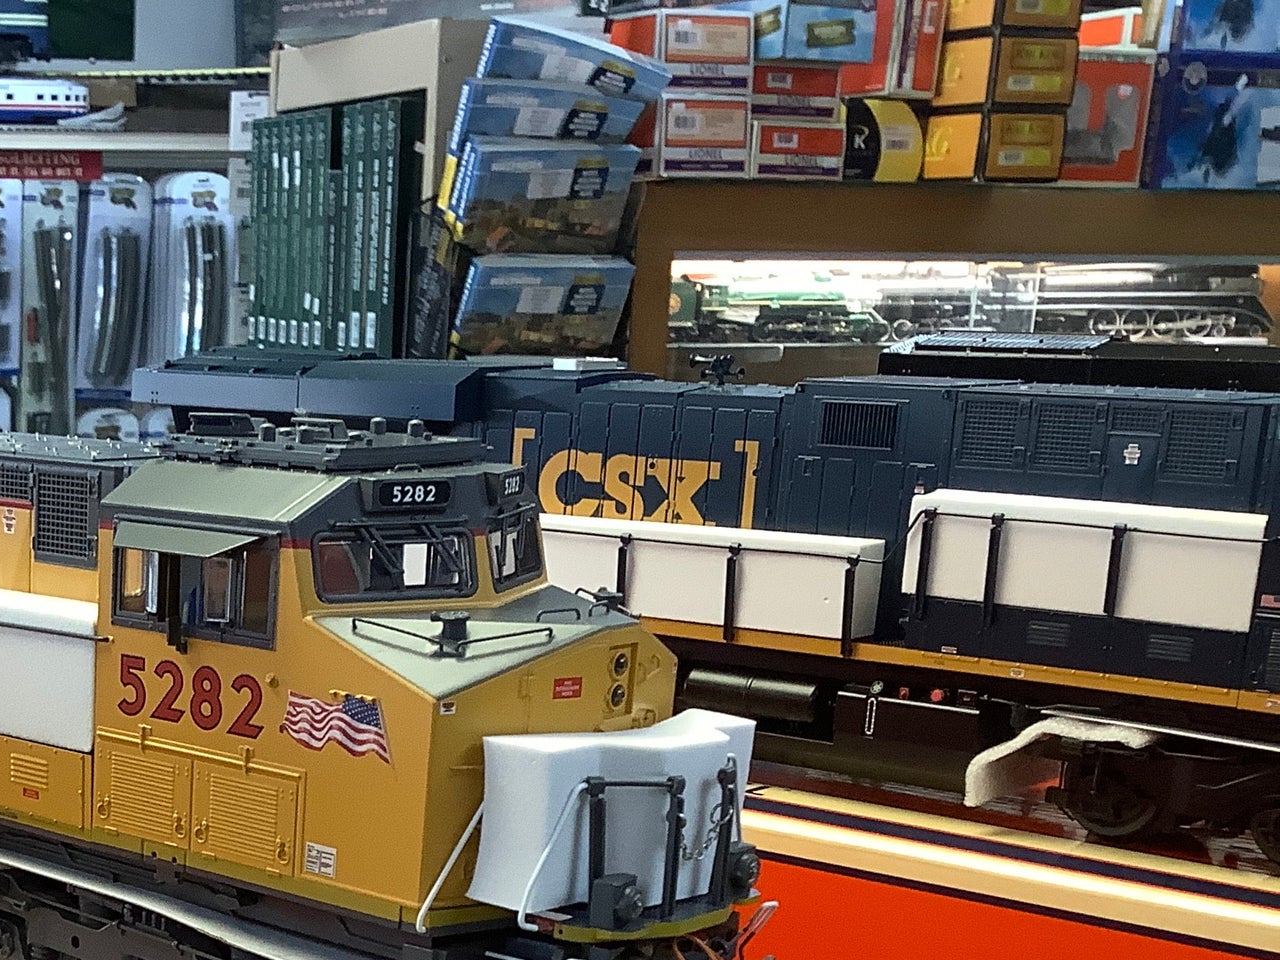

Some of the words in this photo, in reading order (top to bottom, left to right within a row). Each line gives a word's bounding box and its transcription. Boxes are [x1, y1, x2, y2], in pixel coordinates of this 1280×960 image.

[392, 485, 436, 503] 5282
[504, 476, 520, 495] 5282
[538, 449, 721, 526] CSX
[117, 653, 264, 739] 5282
